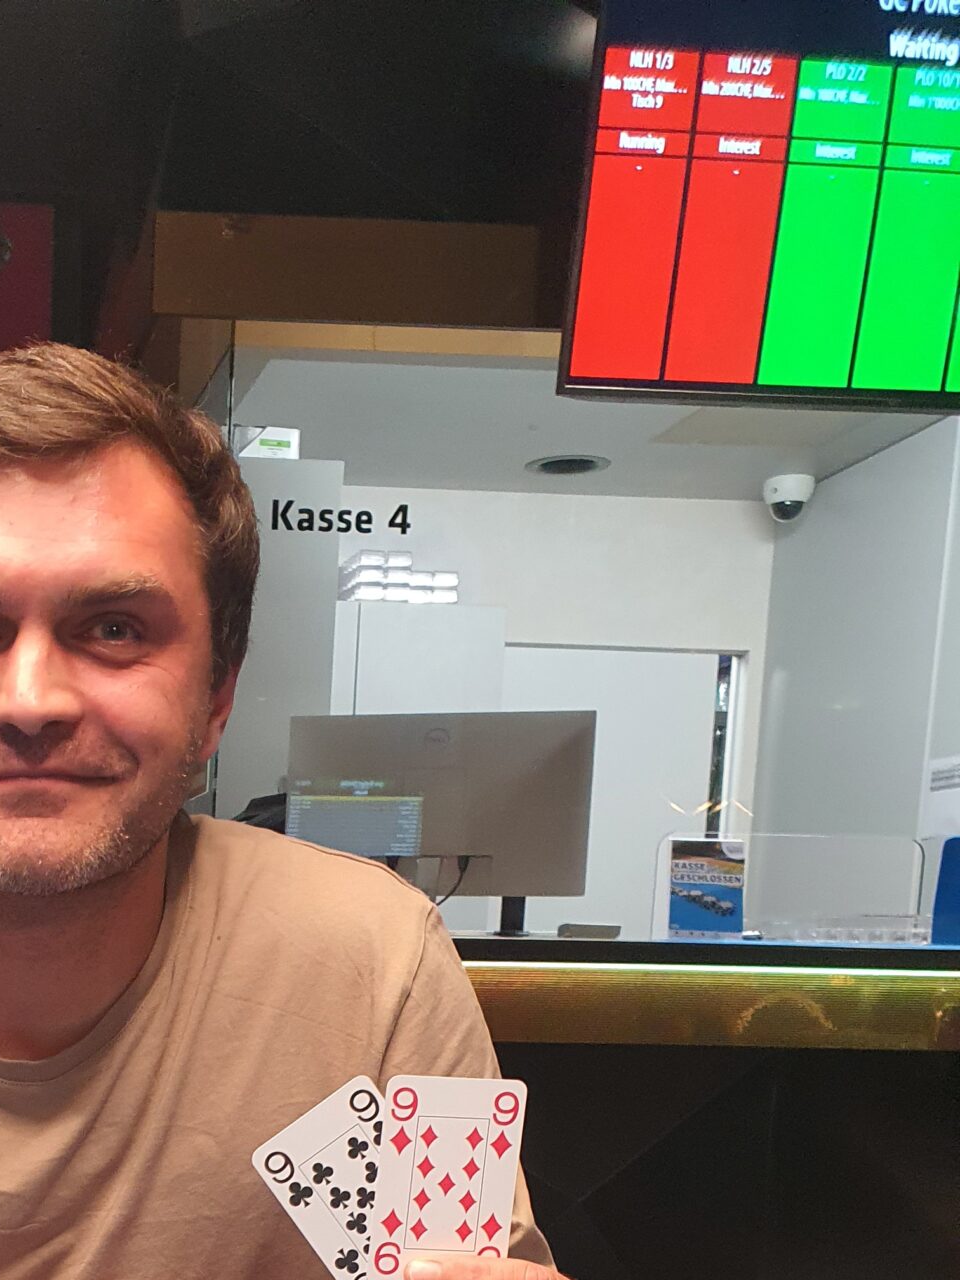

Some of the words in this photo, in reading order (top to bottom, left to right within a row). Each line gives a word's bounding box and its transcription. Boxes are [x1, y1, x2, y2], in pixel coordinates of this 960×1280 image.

[889, 31, 959, 66] Waiting
[271, 499, 373, 534] Kasse
[388, 503, 411, 535] 4
[349, 1089, 380, 1122] 9
[391, 1087, 418, 1121] 9
[492, 1091, 520, 1126] 9
[264, 1151, 295, 1184] 9
